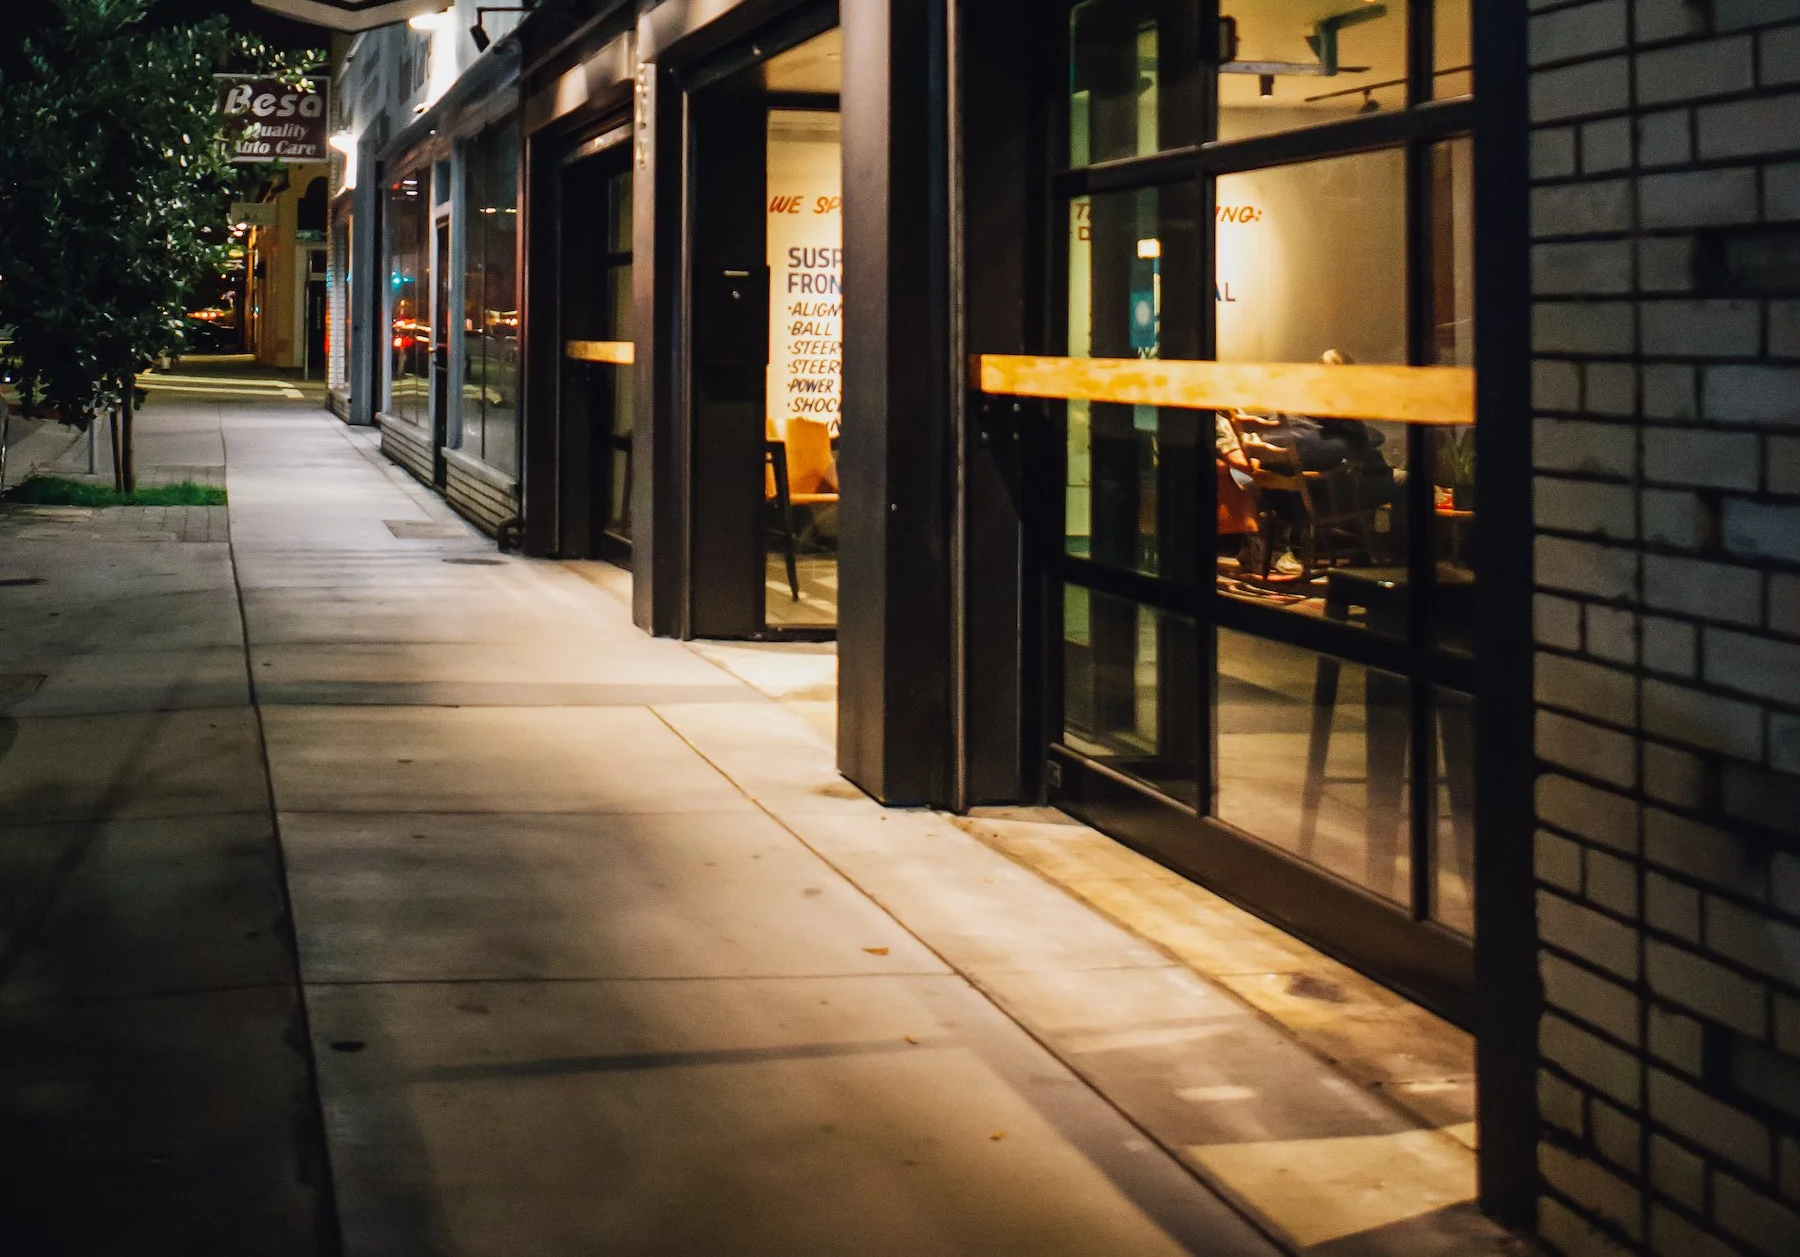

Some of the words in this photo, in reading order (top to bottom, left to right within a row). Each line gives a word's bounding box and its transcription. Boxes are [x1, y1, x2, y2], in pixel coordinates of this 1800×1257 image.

[224, 84, 323, 118] Besa
[275, 140, 317, 155] Care
[769, 195, 803, 214] WE
[813, 196, 843, 215] SP
[791, 320, 833, 336] BALL
[789, 377, 834, 393] POWER
[791, 397, 842, 413] SHOC
